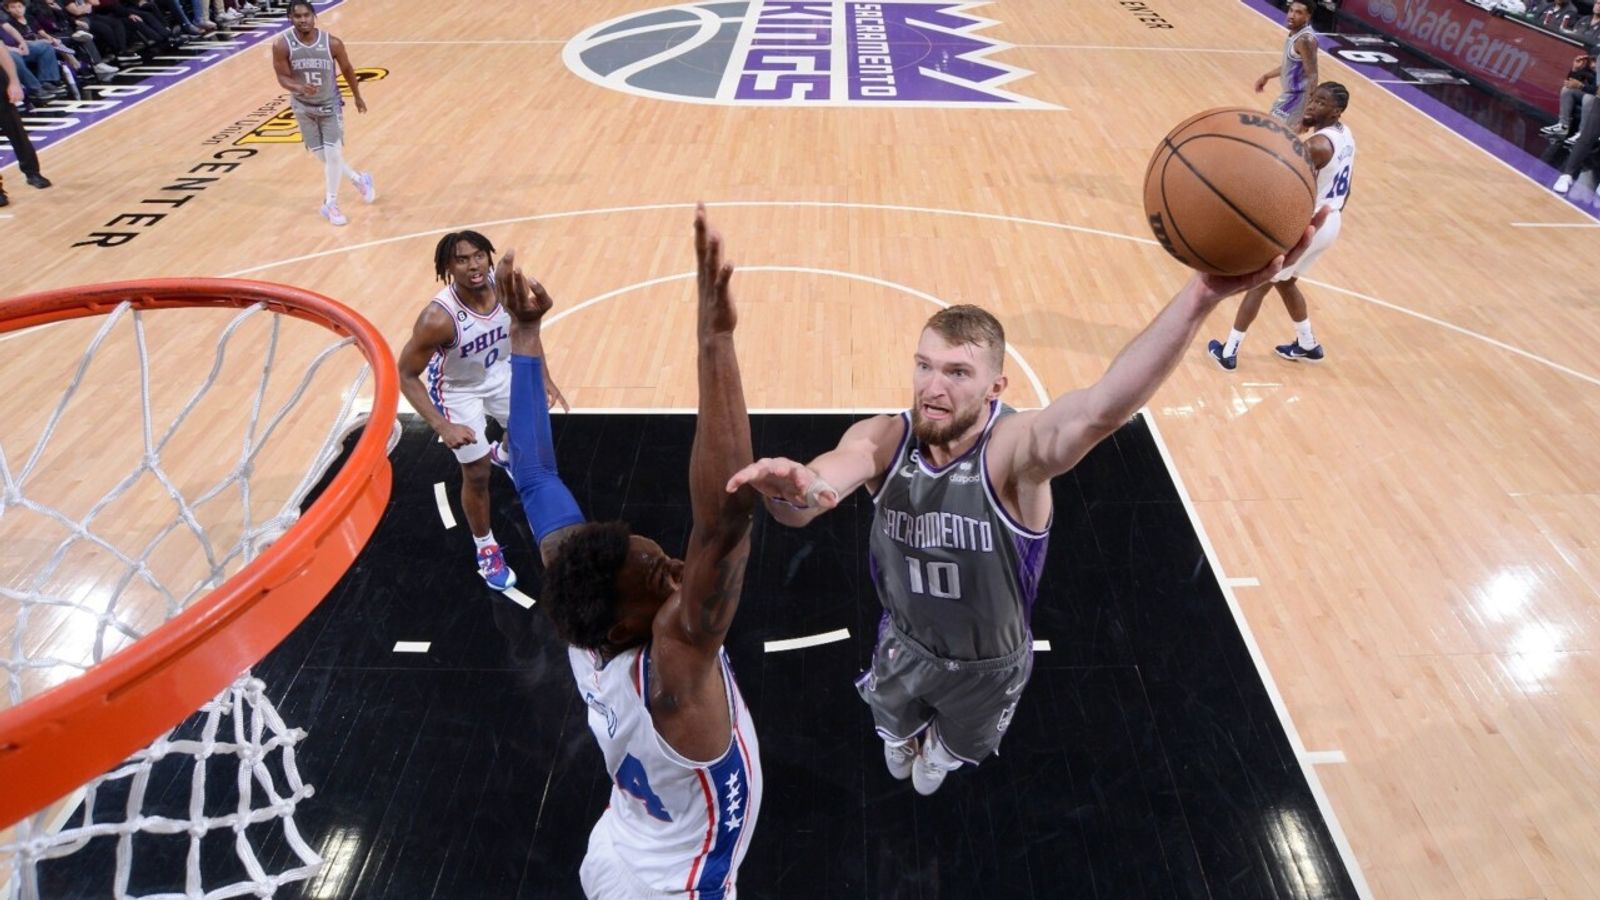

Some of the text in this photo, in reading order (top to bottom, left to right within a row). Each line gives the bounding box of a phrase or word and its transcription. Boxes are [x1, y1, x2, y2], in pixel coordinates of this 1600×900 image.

[1119, 1, 1175, 29] ENTER
[734, 0, 832, 100] KINGS
[853, 3, 897, 97] SACRAMENTO
[1396, 0, 1530, 84] State Farm
[303, 71, 323, 87] 15
[201, 119, 261, 146] Union
[70, 148, 259, 249] CENTER
[1325, 164, 1351, 199] 18
[460, 325, 511, 359] PHIL
[484, 347, 500, 370] 0
[904, 555, 963, 600] 10
[615, 751, 675, 824] 4
